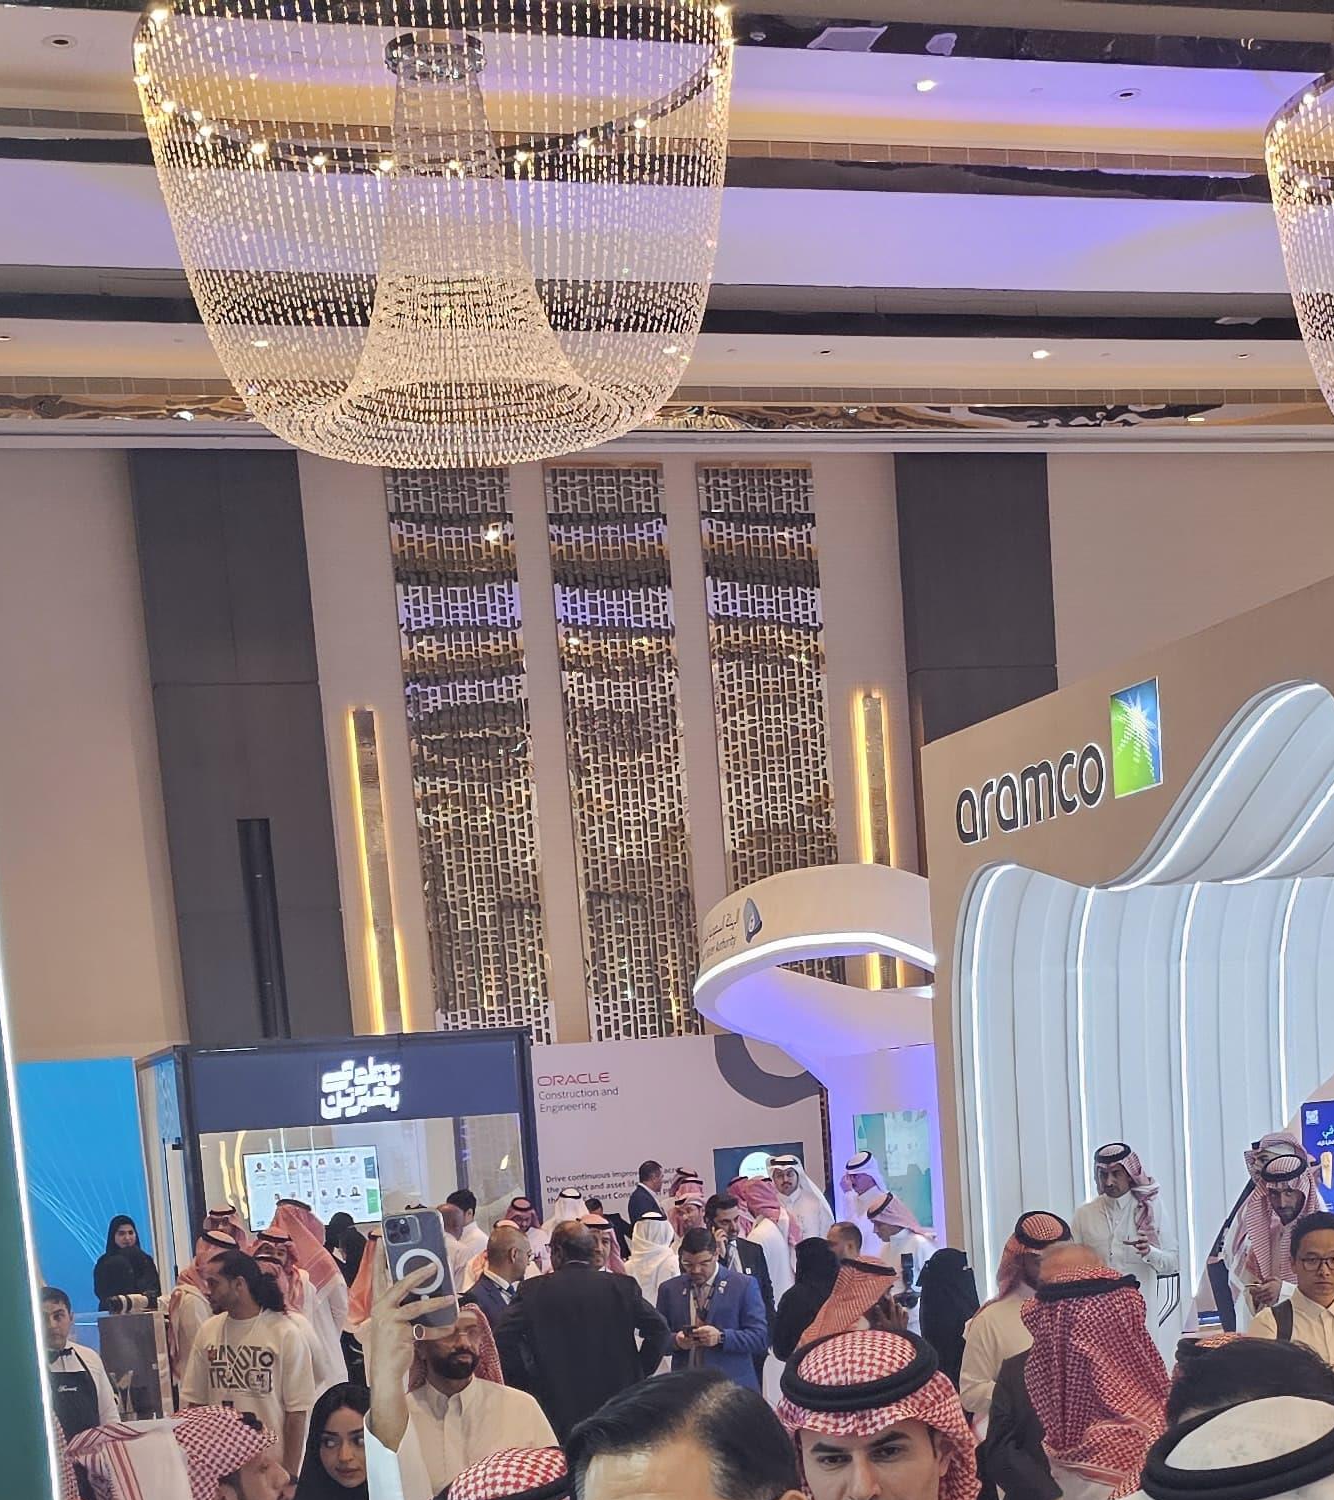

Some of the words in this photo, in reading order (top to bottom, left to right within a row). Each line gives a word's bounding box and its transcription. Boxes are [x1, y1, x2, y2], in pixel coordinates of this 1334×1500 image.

[956, 743, 1105, 845] aramco
[537, 1072, 610, 1086] ORACLE
[538, 1090, 599, 1101] Construction
[601, 1087, 619, 1096] and
[539, 1102, 597, 1114] Engineering
[568, 1172, 611, 1181] continuous
[590, 1182, 604, 1190] and
